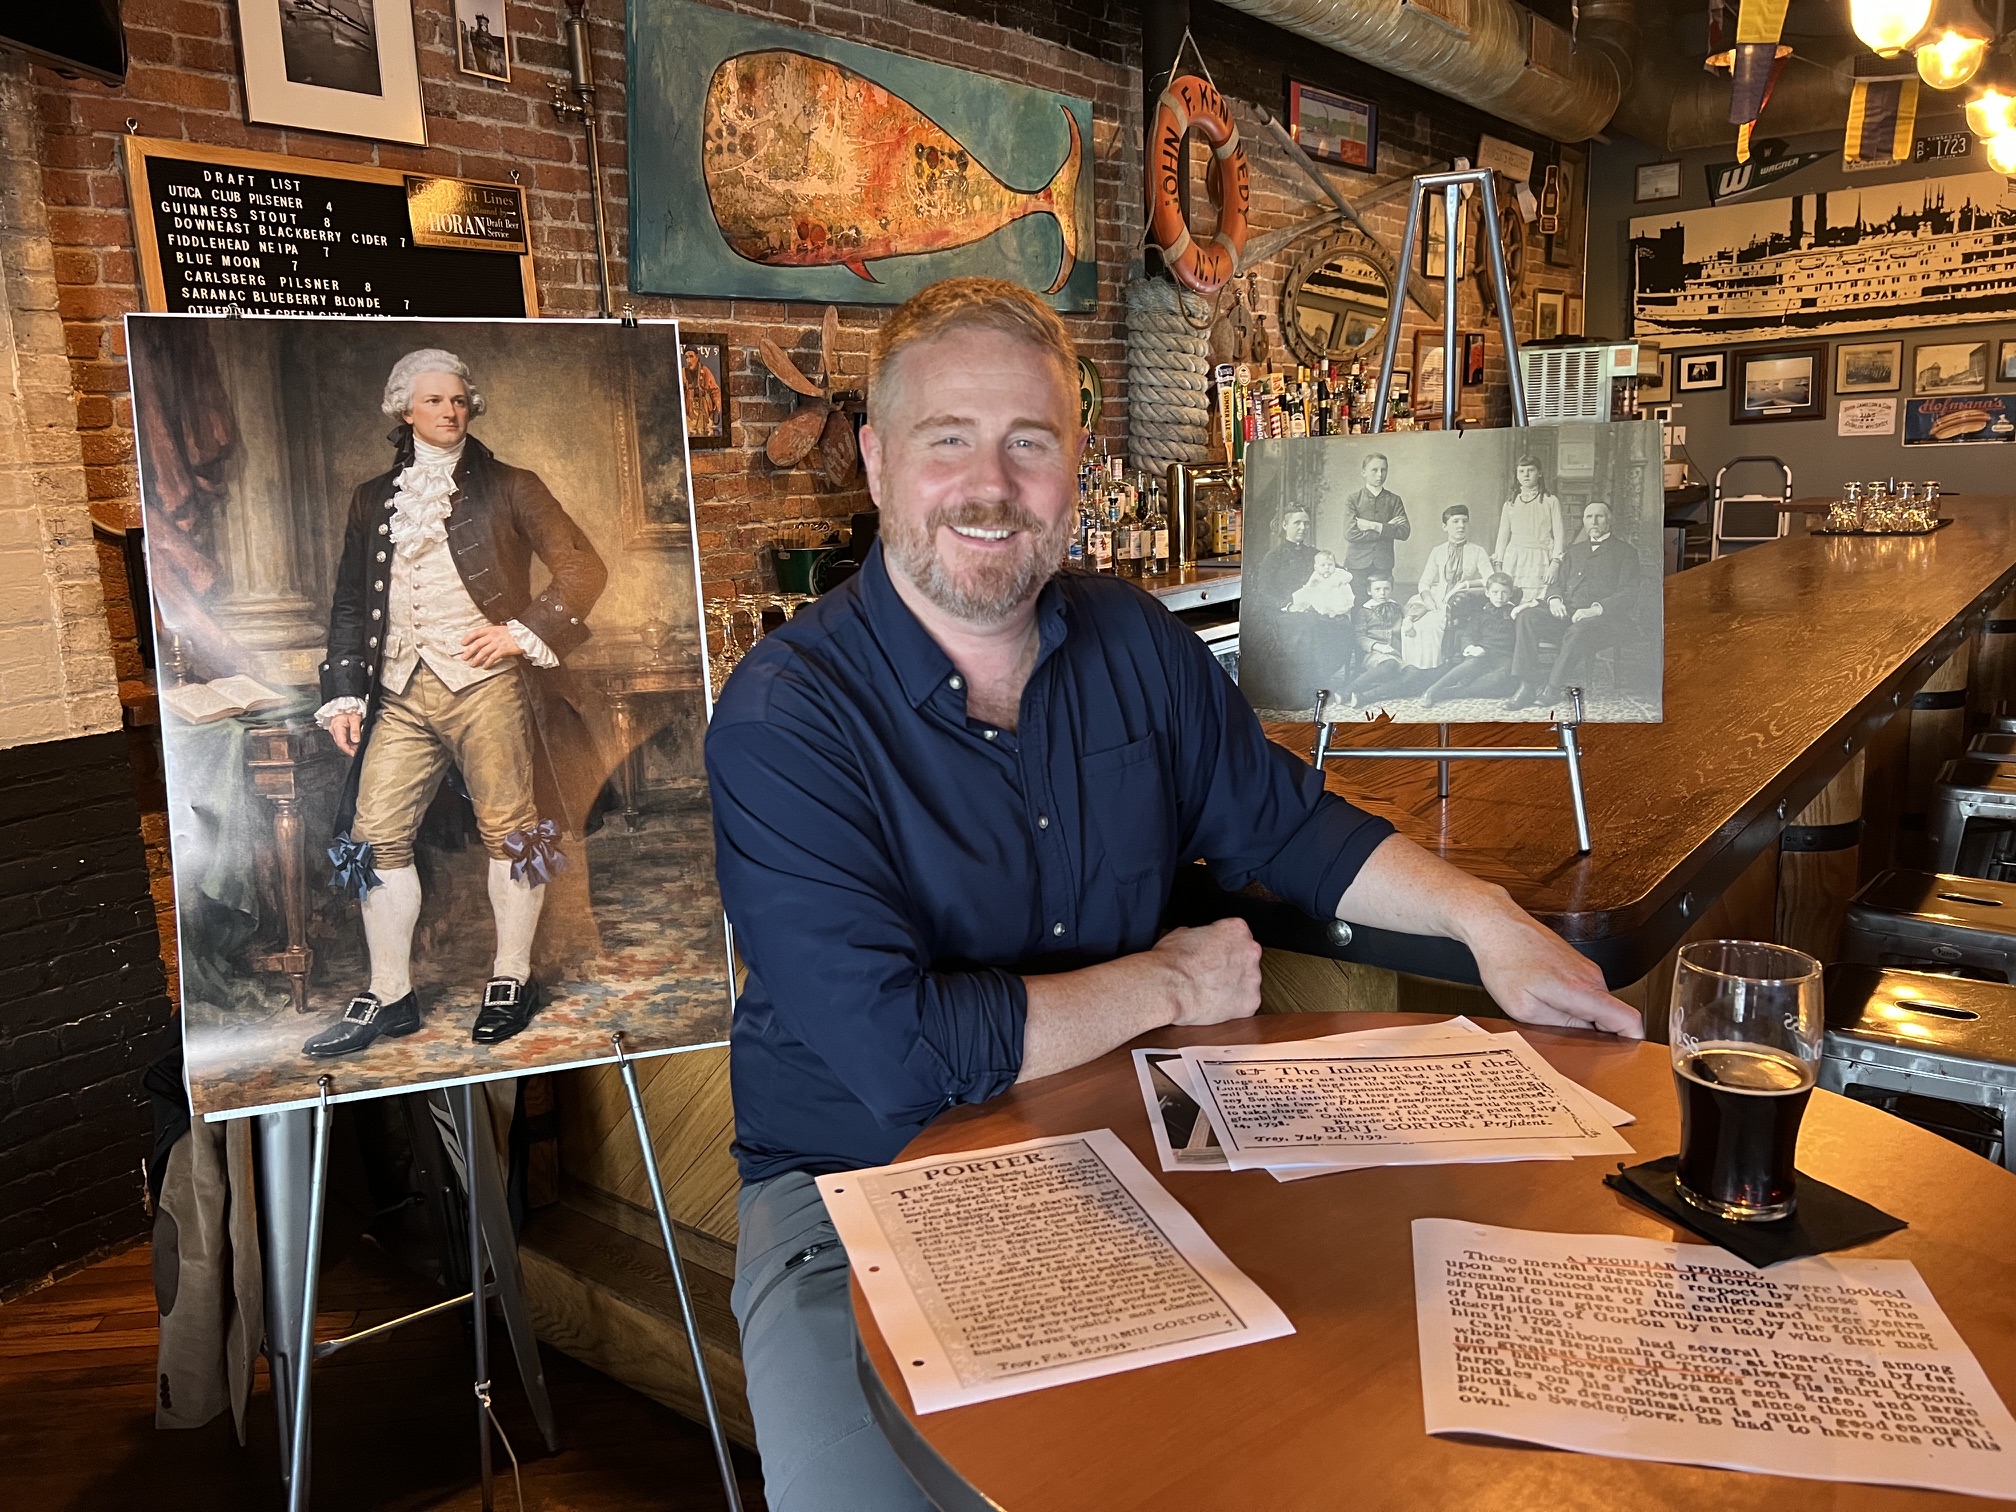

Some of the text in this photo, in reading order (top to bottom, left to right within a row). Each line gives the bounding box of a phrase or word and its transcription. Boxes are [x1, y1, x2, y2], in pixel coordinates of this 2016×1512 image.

[1937, 137, 1966, 156] 1723
[1760, 158, 1799, 174] WAGNER
[203, 170, 300, 191] DRAFT LIST
[1719, 164, 1753, 196] W
[168, 184, 332, 212] UTICA CLUB PILSENER 4
[482, 190, 514, 206] Lines
[161, 201, 331, 228] GUINNESS STOUT 8
[486, 217, 519, 230] Draft Beer
[174, 216, 406, 248] DOWNEAST BLACKBERRY CIDER 7
[487, 228, 510, 239] Service
[167, 234, 330, 258] FIDDLEHEAD NEIPA 7
[176, 251, 298, 271] BLUE MOON 7
[1194, 250, 1221, 285] N.Y.
[184, 270, 372, 292] CARLSBERG PILSNER 8
[181, 287, 410, 310] SARANAC BLUEBERRY BLONDE 7
[1843, 290, 1898, 303] TROJAN
[1919, 397, 2005, 414] Hofmann's
[1275, 1058, 1518, 1075] The Inhabitants of the
[1321, 1124, 1377, 1135] BENJ.
[1354, 1117, 1385, 1125] order
[1430, 1113, 1468, 1121] Board
[1294, 1133, 1322, 1141] July
[924, 1153, 1054, 1180] PORTER.
[1462, 1249, 1906, 1299] These mental vagaries of Gorton were looked
[1565, 1255, 1578, 1263] A
[1586, 1256, 1678, 1271] PECULIAR
[1445, 1259, 1912, 1309] upon with considerable respect by those who
[1446, 1267, 1919, 1320] became imbued with his religious views. The
[1446, 1278, 1925, 1330] singular contrast of the earlier and later years
[1447, 1288, 1933, 1342] of his life is given prominence by the following
[1449, 1297, 1556, 1317] description
[1562, 1308, 1584, 1320] of
[1593, 1312, 1666, 1328] Gorton
[1674, 1320, 1699, 1333] by
[1710, 1325, 1723, 1334] a
[1731, 1325, 1776, 1340] lady
[1788, 1331, 1832, 1343] who
[1894, 1340, 1938, 1351] met
